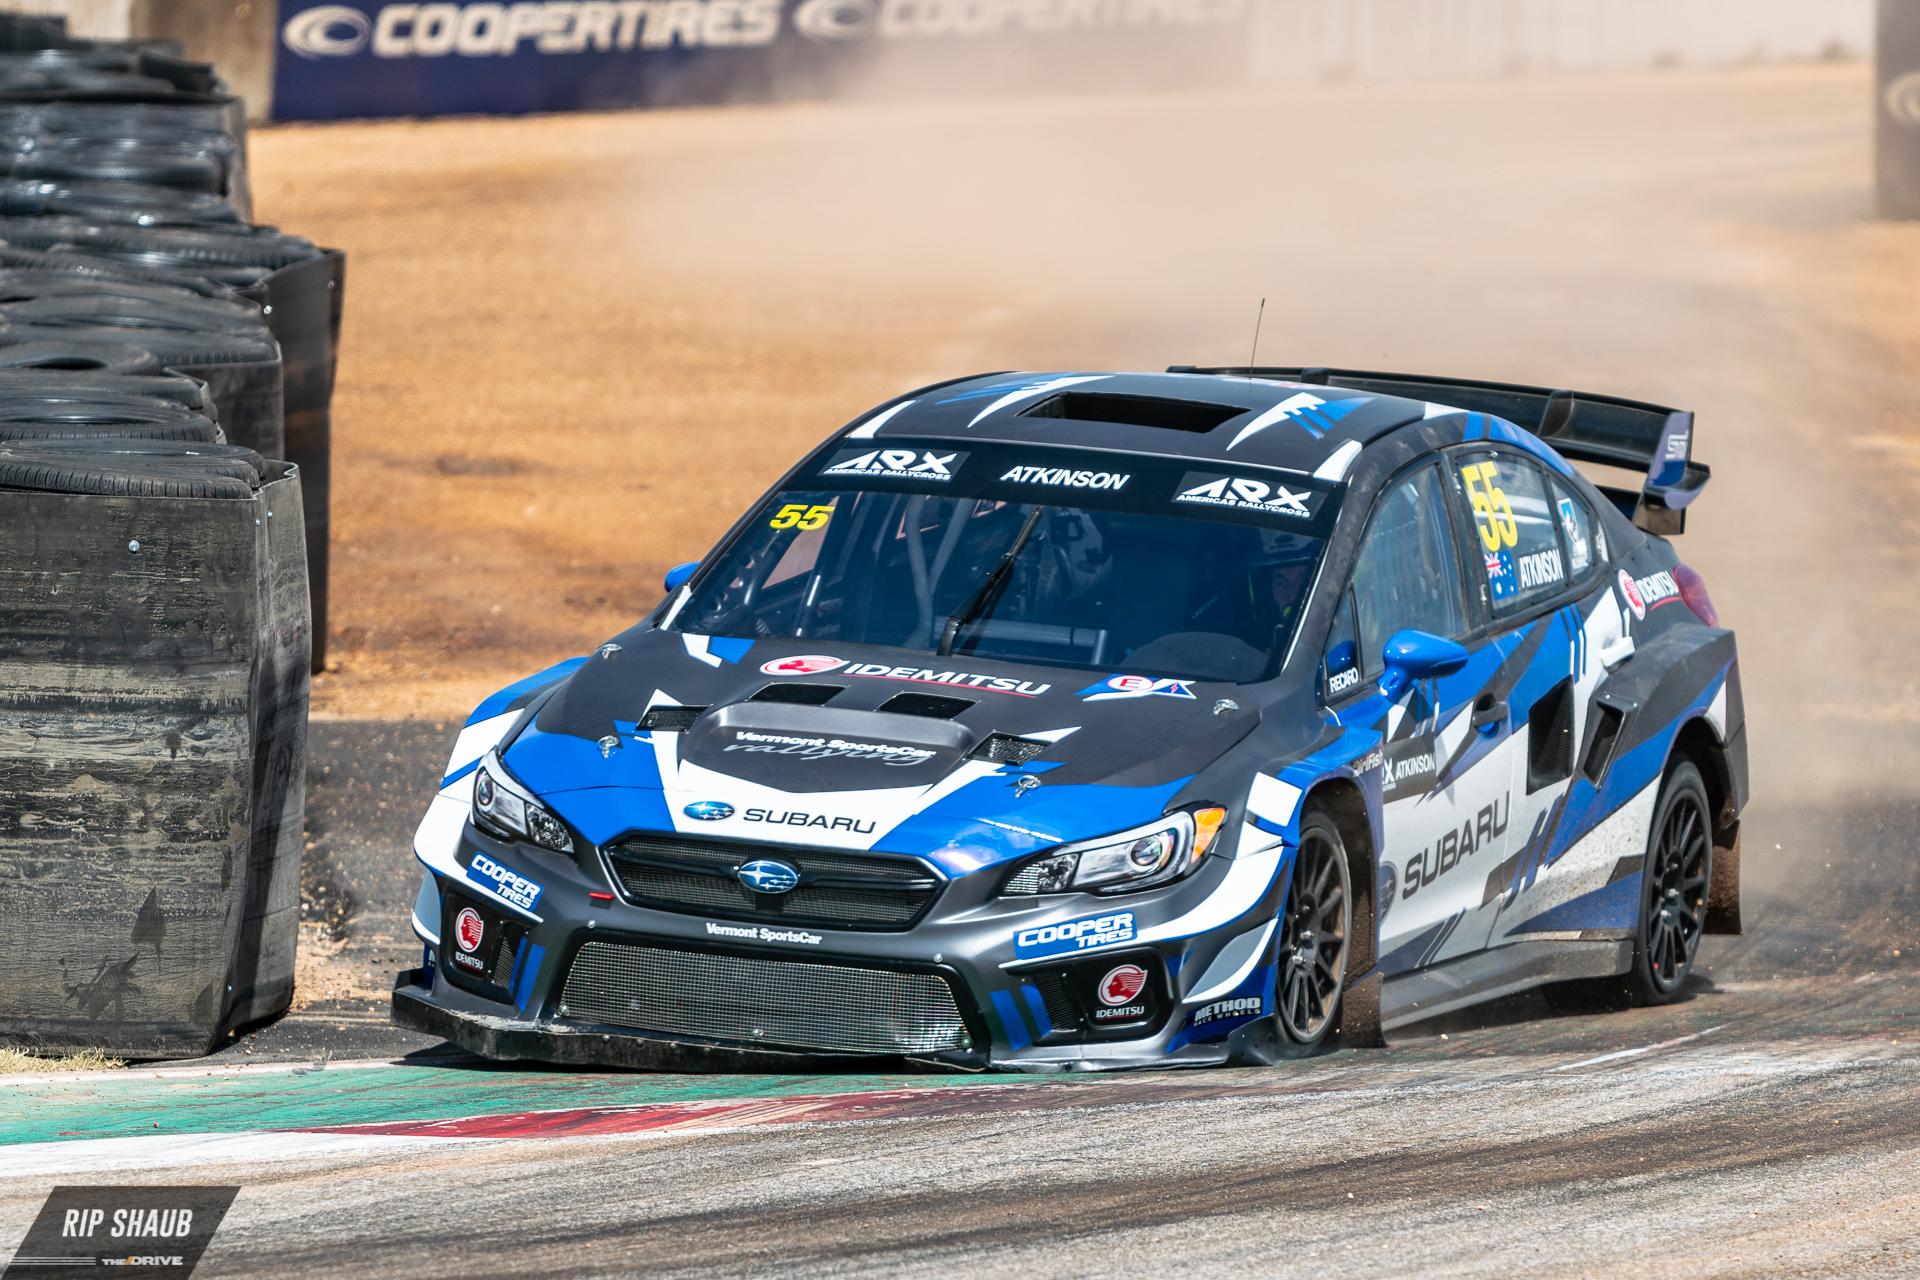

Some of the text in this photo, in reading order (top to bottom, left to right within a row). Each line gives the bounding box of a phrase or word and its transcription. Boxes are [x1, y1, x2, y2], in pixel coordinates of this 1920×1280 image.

[823, 467, 952, 481] AMERICAS RALLYCROSS
[830, 450, 958, 474] ARX
[1000, 464, 1131, 490] ATKINSON
[1176, 494, 1311, 518] AMERICAS RALLYCROSS
[1181, 477, 1312, 512] ARX
[1461, 461, 1518, 552] 55
[769, 504, 835, 531] 55
[1519, 549, 1564, 588] ATKINSON
[1635, 570, 1679, 603] IDEMITSU
[844, 662, 1051, 696] IDEMITSU
[1329, 667, 1359, 693] RECARO
[723, 744, 932, 766] rallying
[736, 731, 937, 757] Vermont SportsCar
[1396, 752, 1436, 781] ATKINSON
[743, 808, 876, 834] SUBARU
[1402, 790, 1510, 900] SUBARU
[471, 854, 541, 899] COOPER
[497, 883, 533, 909] TIRES
[706, 922, 823, 945] Vermont SportsCar
[1017, 913, 1134, 947] COOPER
[1075, 928, 1133, 948] TIRES
[455, 951, 484, 970] IDEMITSU
[1096, 1005, 1145, 1019] IDEMITSU
